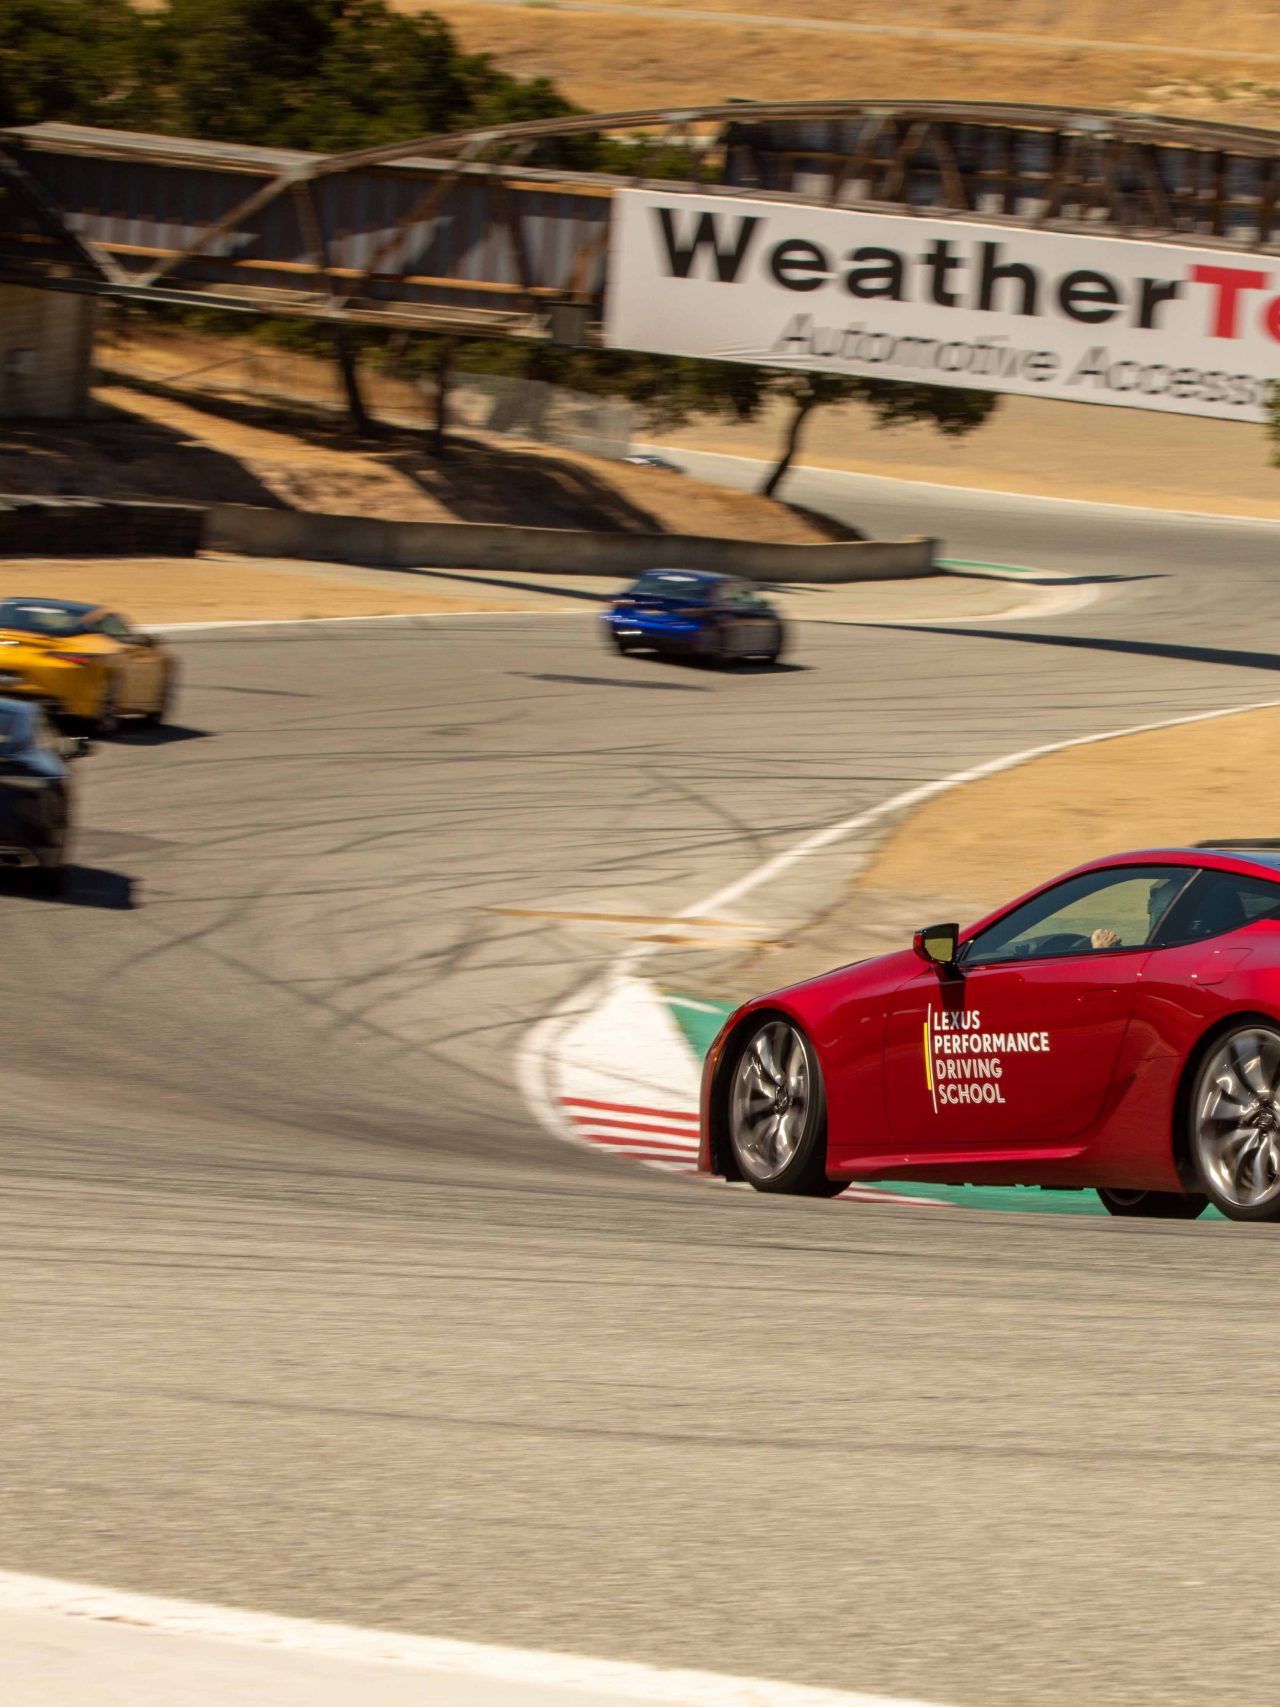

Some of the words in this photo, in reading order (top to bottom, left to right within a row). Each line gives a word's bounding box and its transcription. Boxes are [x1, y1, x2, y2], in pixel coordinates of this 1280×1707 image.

[770, 312, 1061, 382] Automotive
[933, 1010, 980, 1030] LEXUS
[934, 1032, 1050, 1054] PERFORMANCE
[935, 1058, 1002, 1079] DRIVING
[938, 1083, 1006, 1104] SCHOOL
